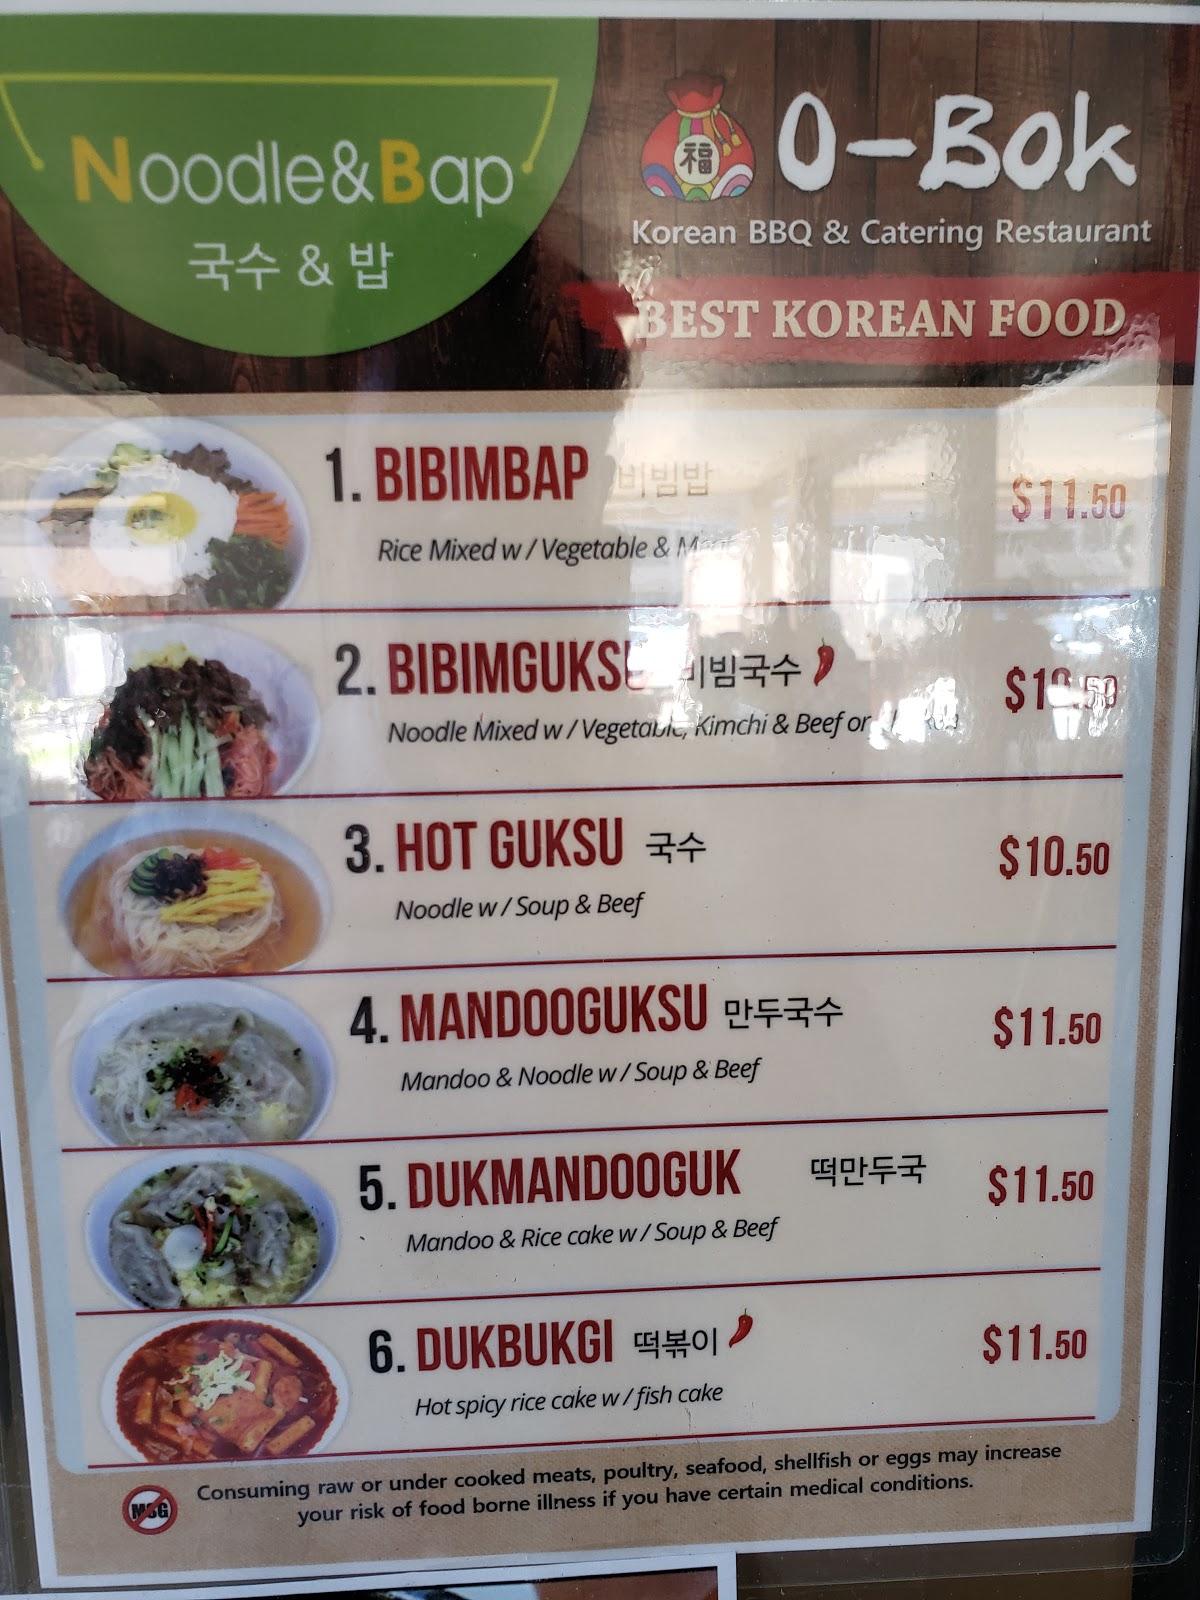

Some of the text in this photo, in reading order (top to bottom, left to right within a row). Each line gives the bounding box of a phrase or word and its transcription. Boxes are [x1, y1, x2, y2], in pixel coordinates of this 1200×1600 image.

[632, 217, 1152, 252] Korean BBQ & Catering Restaurant
[188, 242, 393, 291] 국수 & 밥
[636, 298, 1127, 339] BEST KOREAN FOOD
[325, 445, 589, 502] 1. BIBIMBAP
[619, 461, 713, 498] 비빔밥
[1011, 474, 1127, 522] $11.50
[379, 539, 422, 562] Rice
[429, 538, 497, 561] Mixed
[542, 537, 648, 566] Vegetable
[653, 537, 670, 558] &
[335, 643, 377, 696] 2.
[388, 720, 468, 743] Noodle
[474, 720, 538, 741] Mixed
[695, 713, 768, 736] Kimchi
[772, 713, 789, 735] &
[795, 711, 845, 739] Beef
[847, 715, 871, 732] or
[345, 817, 623, 874] 3. HOT GUKSU
[646, 832, 707, 864] 국수
[999, 834, 1110, 880] $10.50
[396, 898, 473, 920] Noodle
[516, 895, 569, 920] Soup
[575, 895, 591, 914] &
[598, 892, 645, 918] Beef
[350, 983, 708, 1044] 4. MANDOOGUKSU
[724, 997, 843, 1029] 만두국수
[994, 1006, 1102, 1050] $11.50
[401, 1069, 490, 1091] Mandoo
[495, 1067, 513, 1087] &
[519, 1064, 593, 1086] Noodle
[634, 1061, 687, 1085] Soup
[693, 1060, 709, 1079] &
[715, 1057, 762, 1084] Beef
[359, 1148, 741, 1211] 5. DUKMANDOOGUK
[810, 1154, 927, 1187] 떡만두국
[988, 1165, 1094, 1206] $11.50
[406, 1233, 494, 1253] Mandoo
[500, 1230, 515, 1249] &
[521, 1227, 562, 1248] Rice
[567, 1224, 614, 1245] cake
[654, 1220, 707, 1245] Soup
[712, 1219, 728, 1239] &
[733, 1216, 780, 1242] Beef
[368, 1319, 613, 1374] 6. DUKBUKGI
[634, 1327, 718, 1360] 떡볶이
[983, 1323, 1087, 1365] $11.50
[416, 1396, 453, 1416] Hot
[455, 1395, 506, 1420] spicy
[510, 1392, 547, 1412] rice
[552, 1389, 598, 1409] cake
[634, 1384, 673, 1412] fish
[677, 1384, 724, 1404] cake
[197, 1444, 1062, 1503] Consuming raw or under cooked meats, poultry, seafood, shellfish or eggs may increase
[297, 1471, 974, 1528] your risk of food borne illness if you have certain medical conditions.
